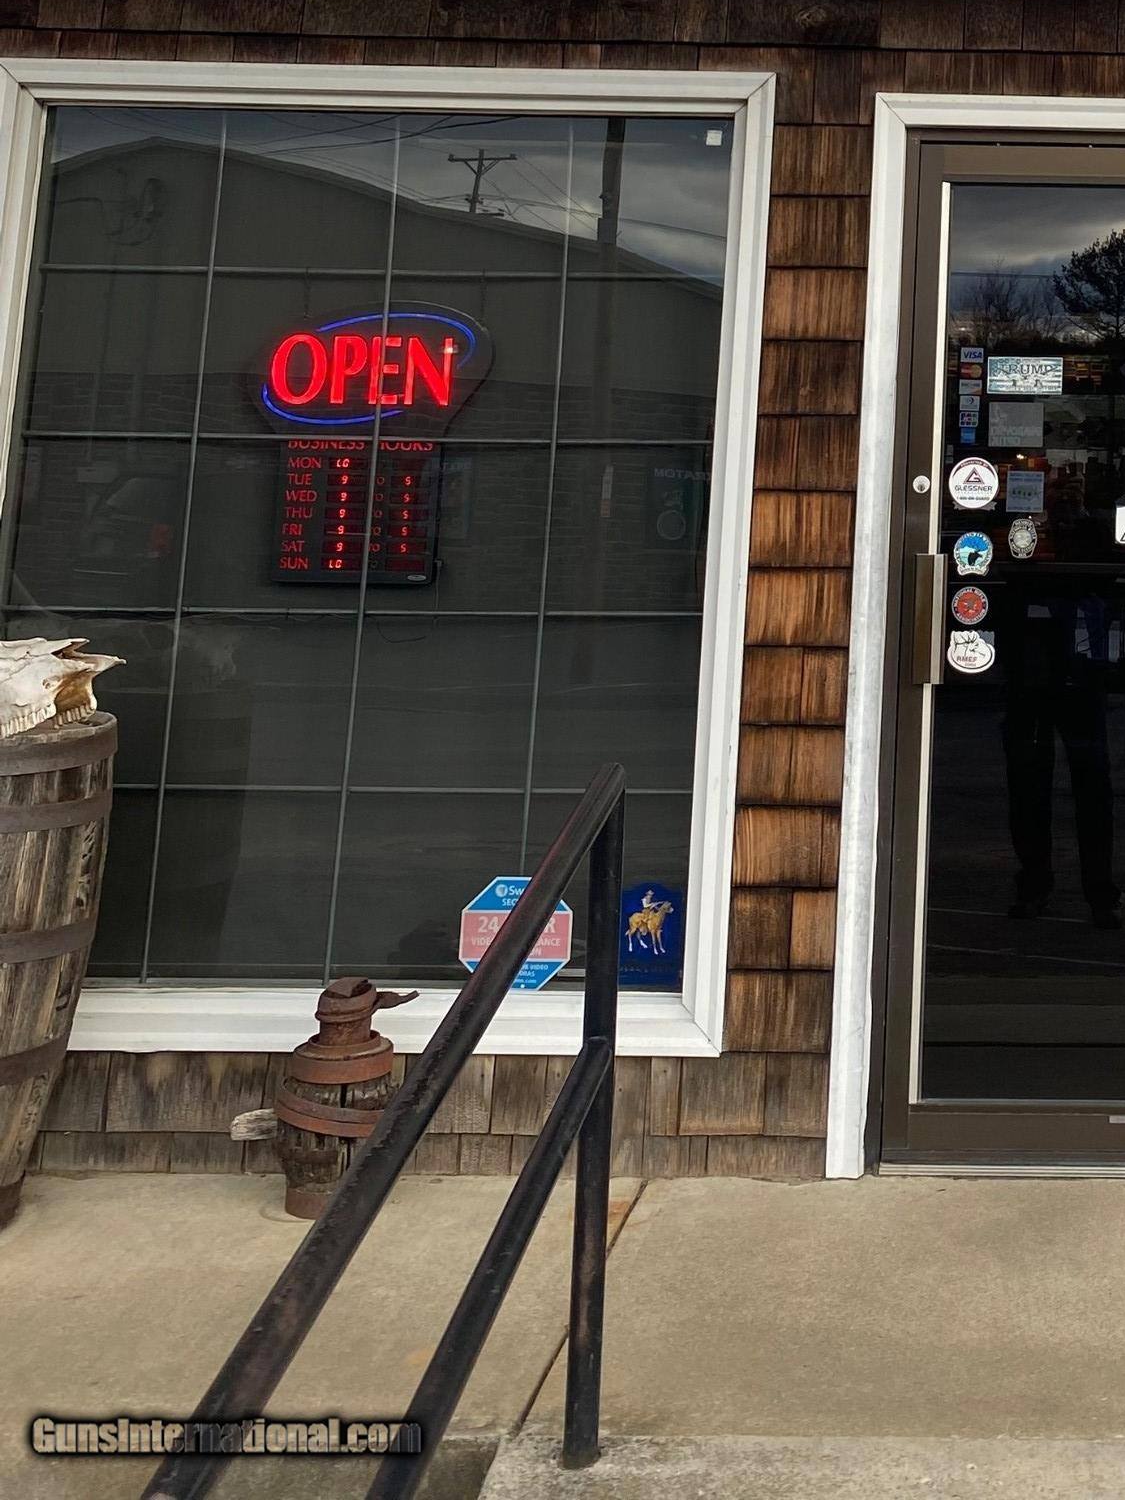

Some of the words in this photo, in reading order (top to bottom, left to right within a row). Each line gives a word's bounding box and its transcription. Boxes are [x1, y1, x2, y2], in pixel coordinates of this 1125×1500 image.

[963, 350, 983, 359] VISA
[271, 333, 454, 406] OPEN
[288, 457, 321, 469] MON
[288, 473, 312, 485] TUE
[955, 484, 993, 492] GLESSNER
[286, 490, 317, 502] WED
[285, 507, 312, 518] THU
[282, 523, 303, 535] FRI
[281, 540, 305, 552] SAT
[280, 557, 309, 569] SUN
[478, 916, 500, 932] 24
